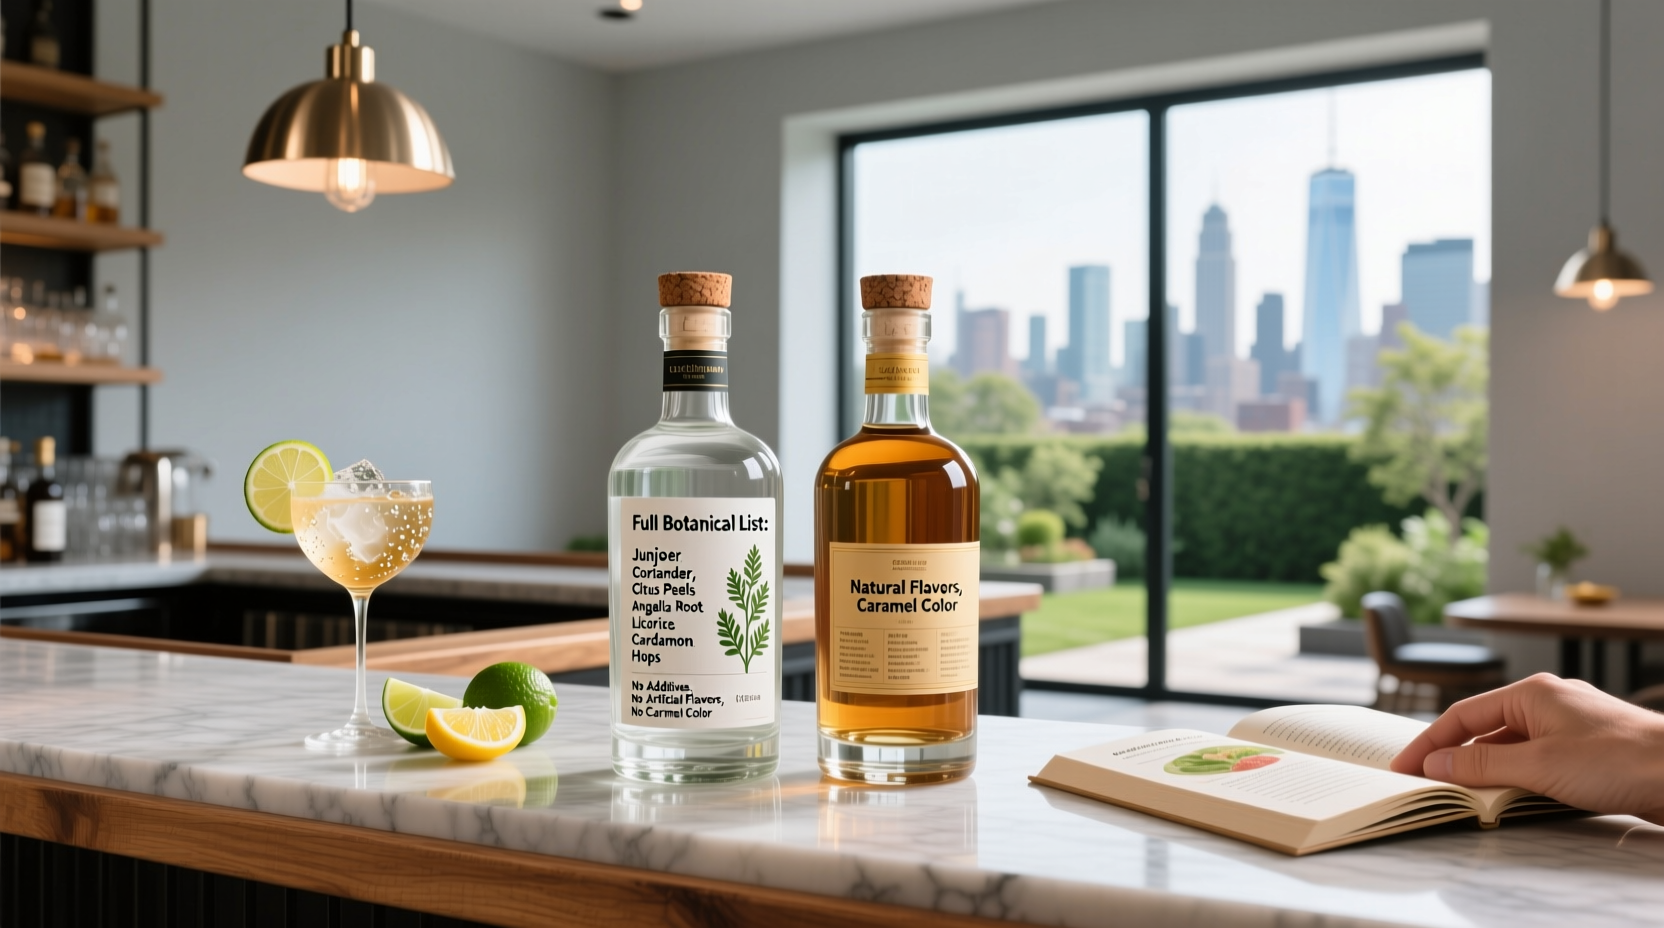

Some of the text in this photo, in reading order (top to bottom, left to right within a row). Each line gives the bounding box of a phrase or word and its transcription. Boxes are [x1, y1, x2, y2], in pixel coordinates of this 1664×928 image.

[632, 514, 769, 532] Full Botanical List:
[663, 582, 696, 597] Peels
[851, 579, 963, 597] Natural Flavors,
[675, 599, 705, 614] Root
[857, 597, 958, 613] Caramel Color
[632, 649, 662, 667] Hops
[631, 680, 644, 691] No
[631, 693, 643, 705] No
[631, 706, 644, 718] No
[685, 707, 714, 719] Color
